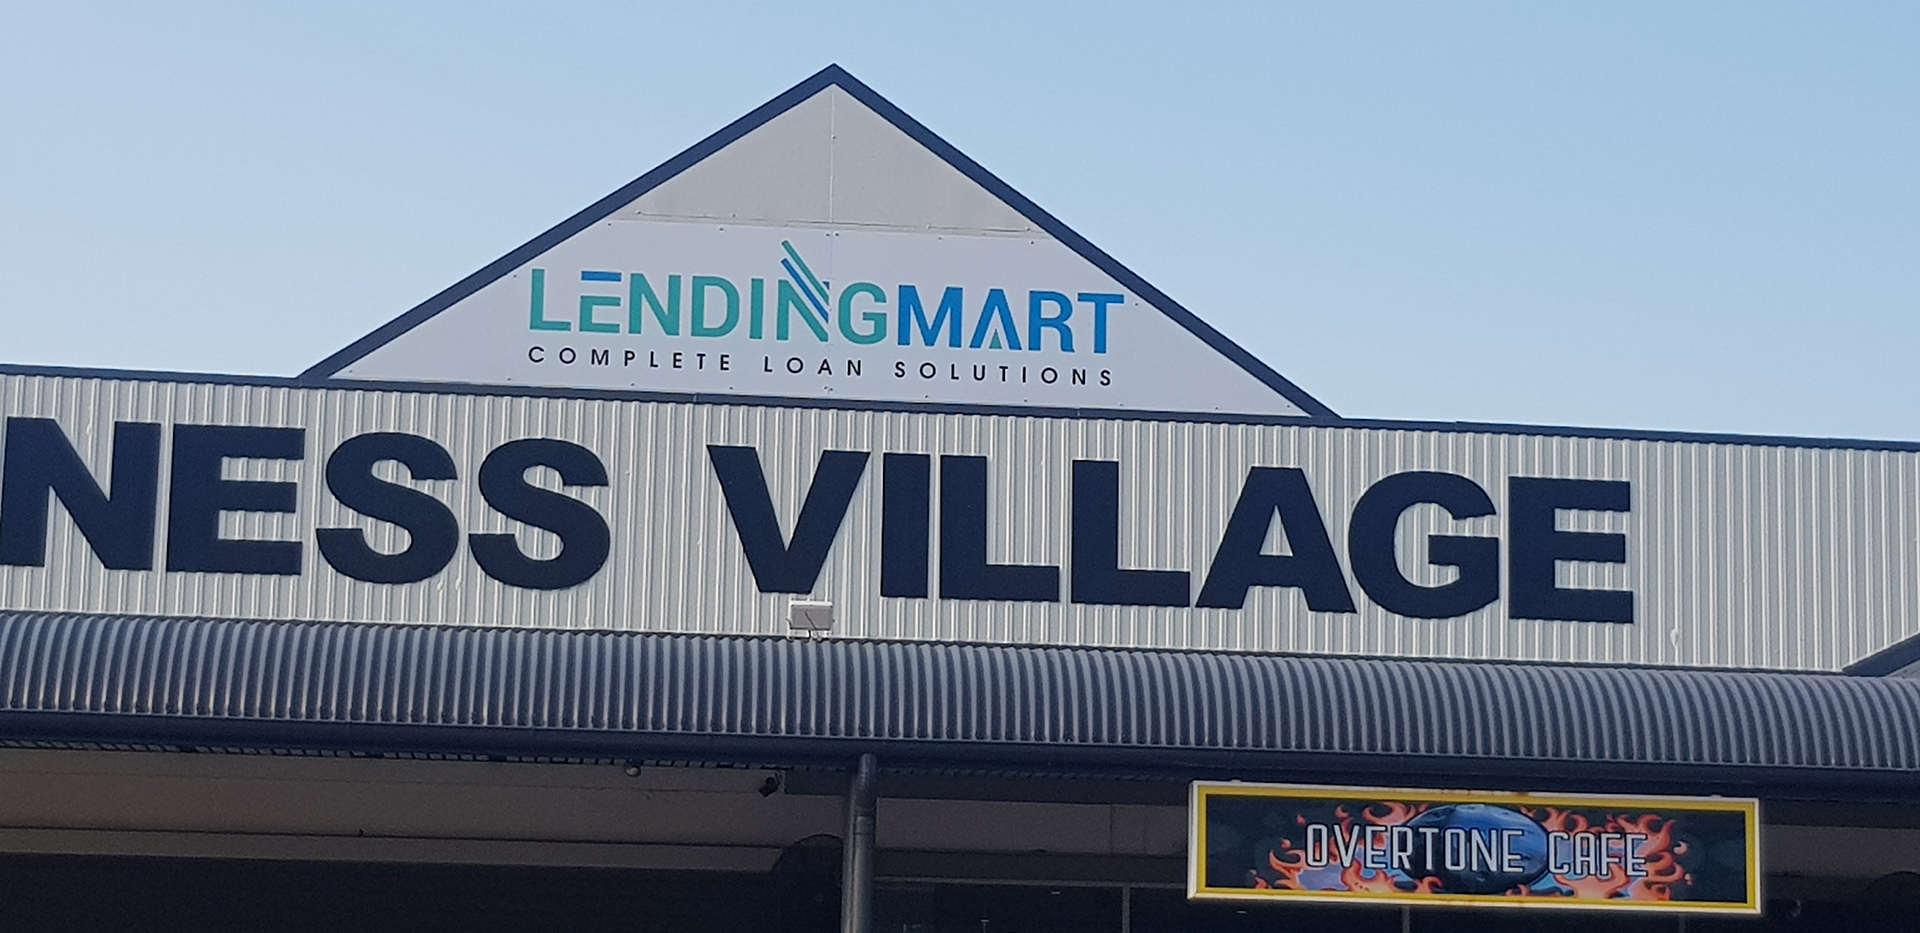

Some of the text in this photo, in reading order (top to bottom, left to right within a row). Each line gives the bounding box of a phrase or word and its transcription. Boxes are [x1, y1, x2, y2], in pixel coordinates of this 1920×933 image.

[528, 240, 1125, 354] LENDINGMART
[528, 346, 1112, 387] COMPLETE LOAN SOLUTIONS
[0, 416, 1634, 624] NESS VILLAGE
[1305, 823, 1649, 878] OVERTONE CAFE
